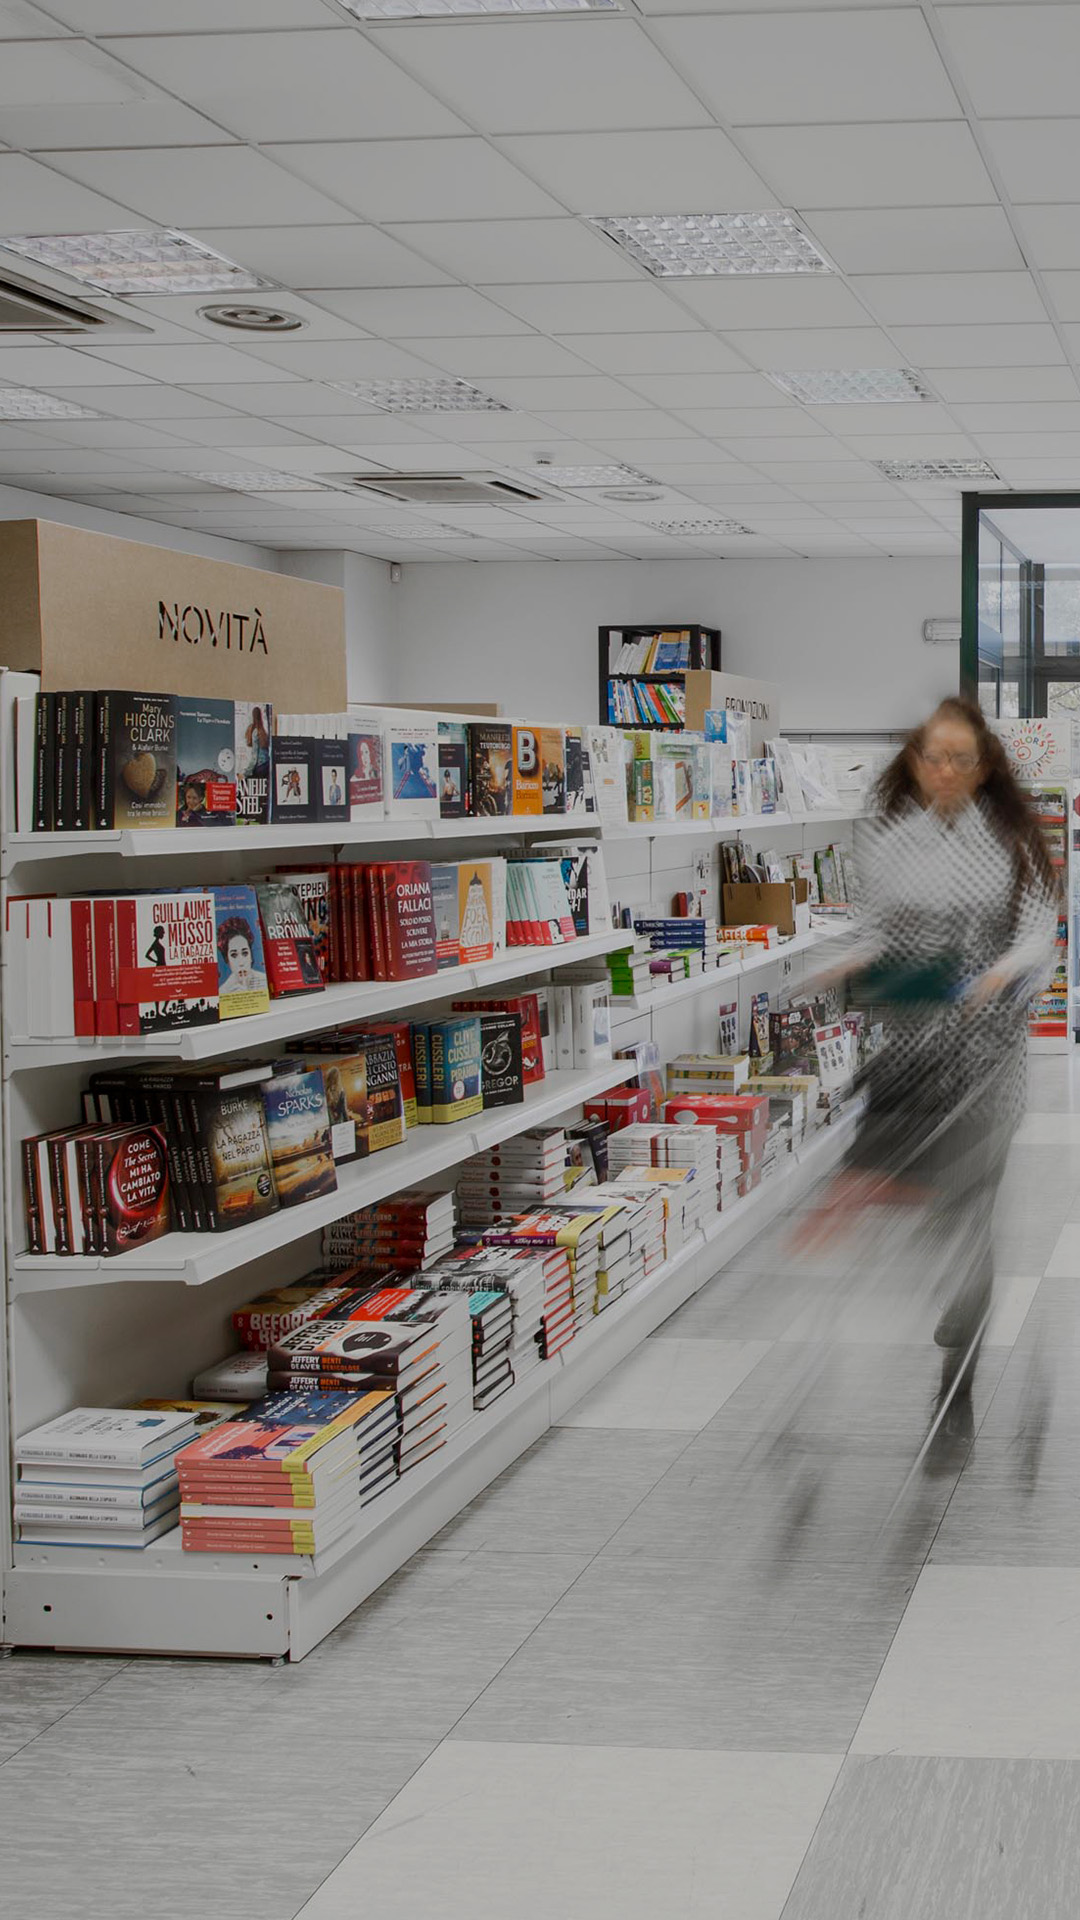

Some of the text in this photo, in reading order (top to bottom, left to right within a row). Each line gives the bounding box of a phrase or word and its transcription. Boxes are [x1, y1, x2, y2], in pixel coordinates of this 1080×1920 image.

[159, 600, 268, 655] NOVITÀ
[142, 703, 162, 715] Mary
[125, 712, 175, 729] HIGGINS
[130, 727, 170, 743] CLARK
[517, 730, 536, 771] B
[236, 778, 267, 797] ANIELLE
[236, 796, 263, 815] STEEL
[396, 882, 431, 898] ORIANA
[152, 900, 212, 925] GUILLAUME
[301, 895, 327, 921] ING
[397, 897, 432, 915] FALLACI
[274, 912, 298, 926] DAN
[168, 920, 213, 948] MUSSO
[267, 925, 310, 940] BROWN
[168, 945, 214, 961] LA RAGAZZA
[415, 1034, 427, 1082] CUSSLER
[432, 1034, 444, 1082] CUSSLER
[372, 1060, 397, 1075] CENTO
[366, 1070, 398, 1087] NGANNI
[220, 1100, 249, 1116] BURKE
[278, 1093, 323, 1118] SPARKS
[127, 1139, 150, 1155] COME
[216, 1130, 261, 1150] LA RAGAZZA
[124, 1150, 158, 1169] The Secret
[222, 1143, 261, 1162] NEL PARCO
[130, 1165, 152, 1180] MI HA
[120, 1171, 161, 1193] CAMBIATO
[126, 1186, 156, 1204] LA VITA
[250, 1313, 311, 1331] BEFORE
[290, 1356, 320, 1365] JEFFERY
[290, 1363, 320, 1371] DEAVER
[289, 1376, 319, 1386] JEFFERY
